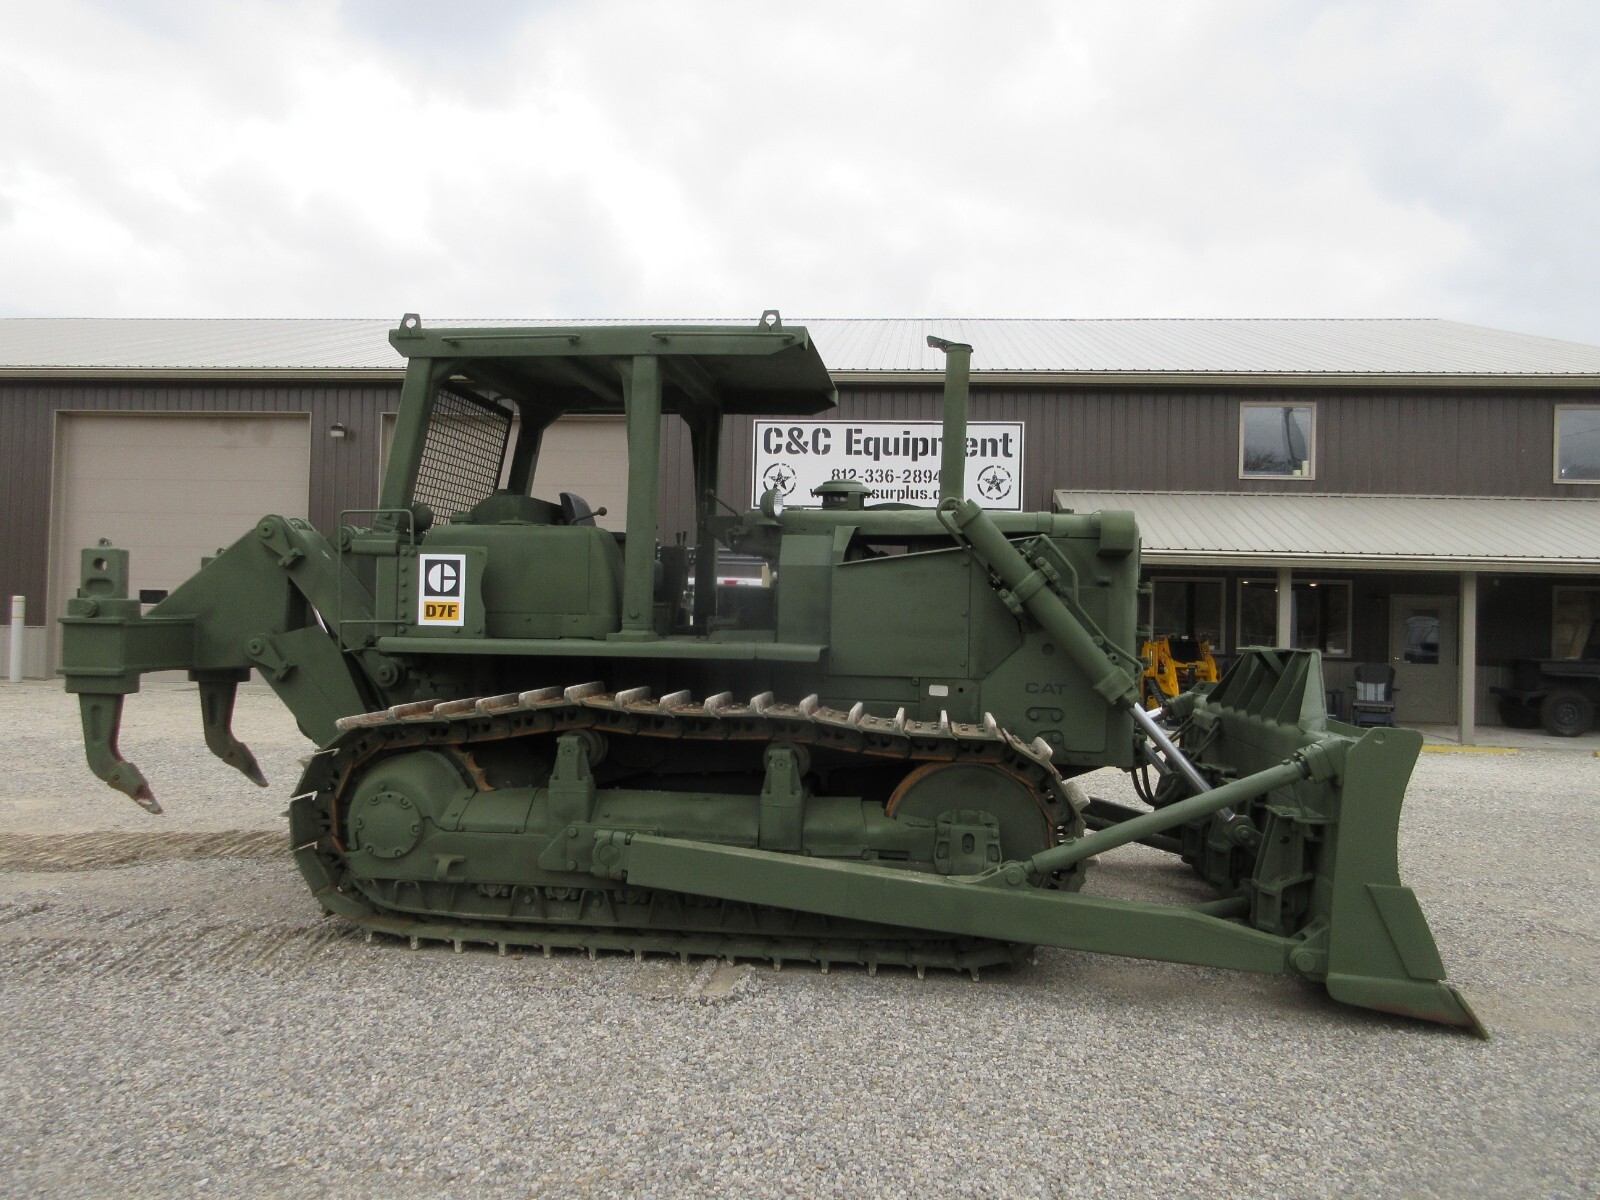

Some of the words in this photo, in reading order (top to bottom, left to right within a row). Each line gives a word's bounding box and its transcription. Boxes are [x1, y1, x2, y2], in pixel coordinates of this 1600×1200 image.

[763, 427, 831, 455] C&C
[426, 605, 457, 617] D7F
[1025, 682, 1067, 694] CAT
